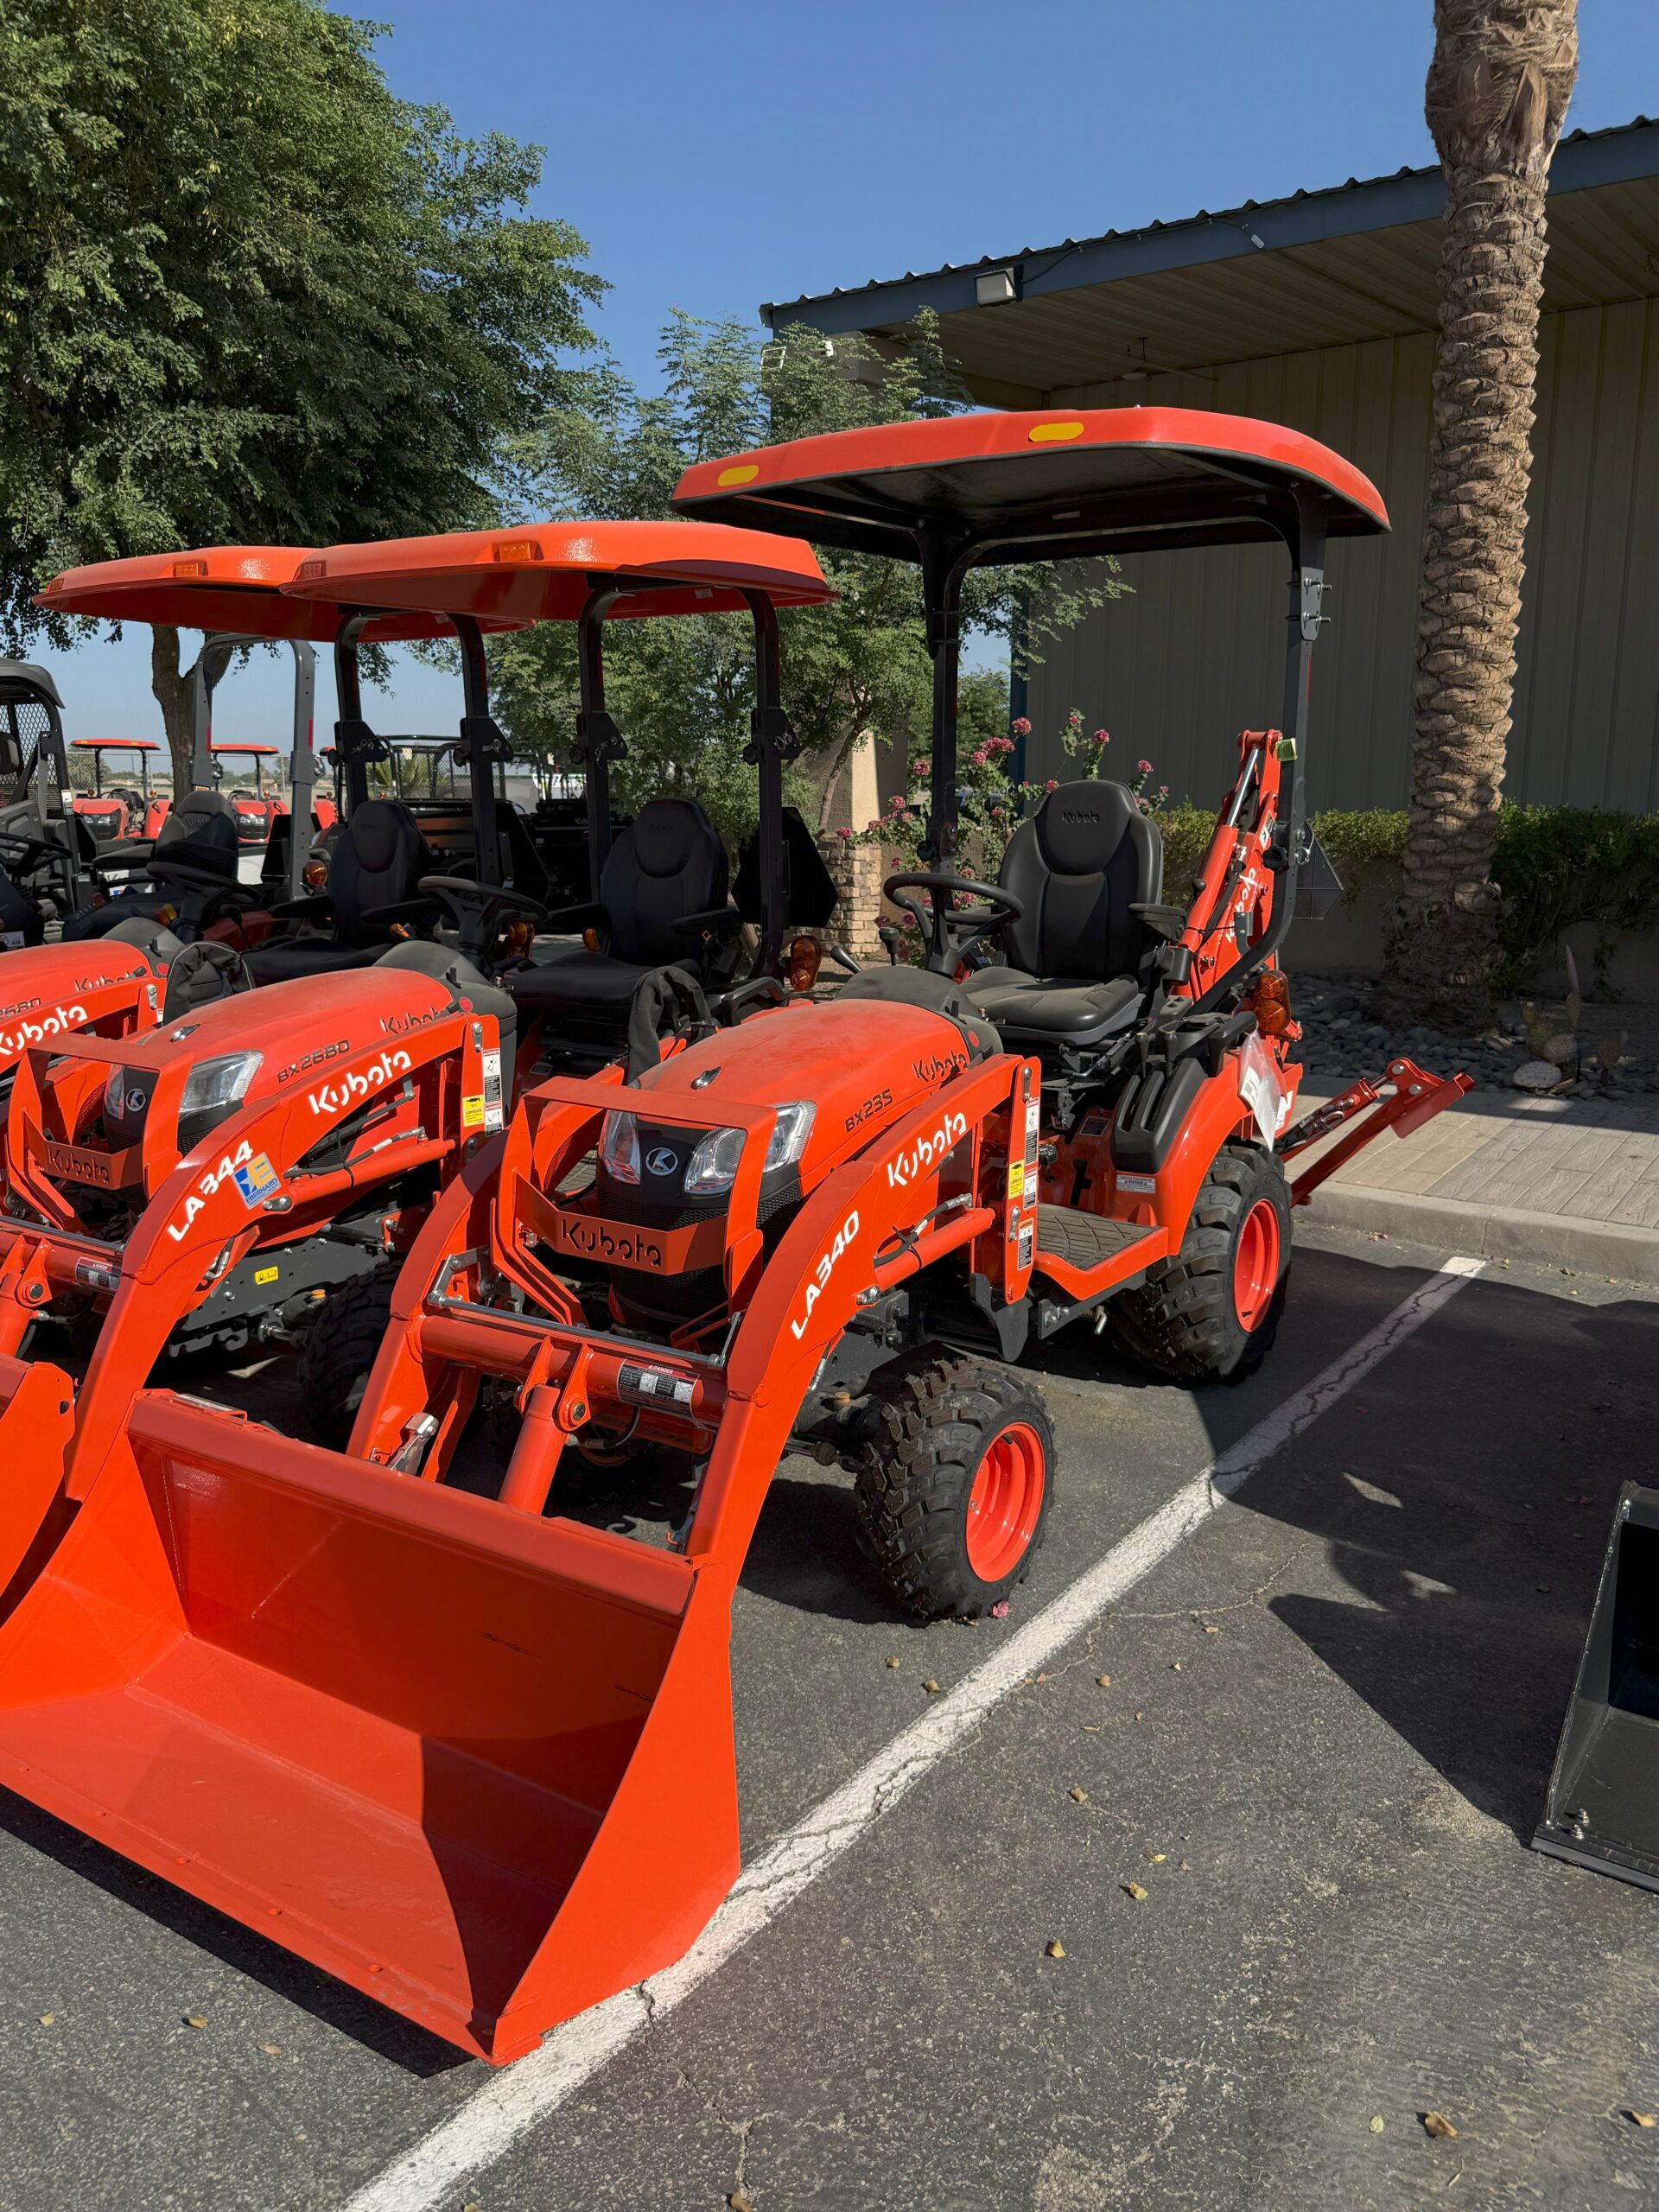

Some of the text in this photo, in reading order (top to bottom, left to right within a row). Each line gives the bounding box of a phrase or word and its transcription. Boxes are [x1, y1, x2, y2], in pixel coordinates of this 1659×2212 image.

[379, 1006, 448, 1035] Kubot
[276, 1039, 350, 1084] BX2680
[308, 1050, 413, 1116] Kubota
[48, 1147, 111, 1184] Kubota
[887, 1111, 967, 1189] Kubota
[167, 1139, 254, 1243] LA344
[245, 1178, 278, 1205] EBERHARD
[561, 1218, 662, 1267] Kubota
[790, 1210, 860, 1340] LA340
